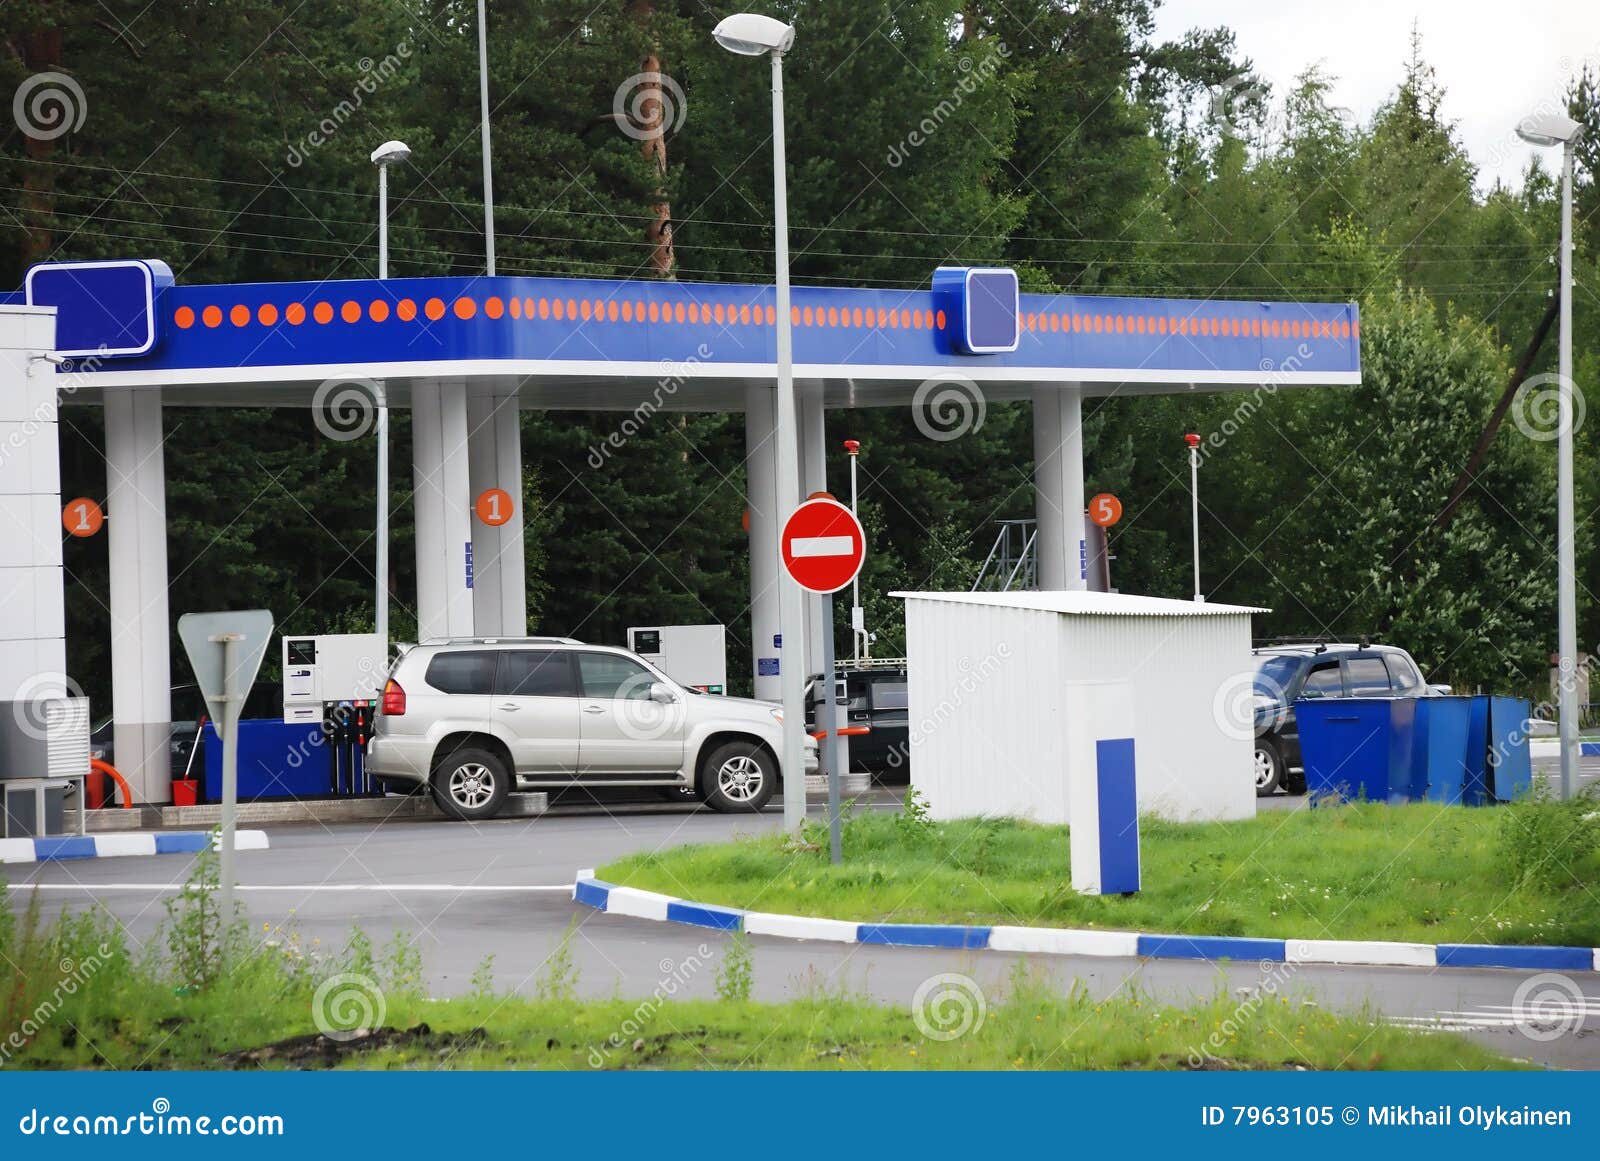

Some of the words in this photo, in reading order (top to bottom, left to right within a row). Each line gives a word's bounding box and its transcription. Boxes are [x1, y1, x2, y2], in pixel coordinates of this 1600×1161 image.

[73, 503, 91, 530] 1
[487, 494, 502, 520] 1
[1098, 498, 1113, 522] 5
